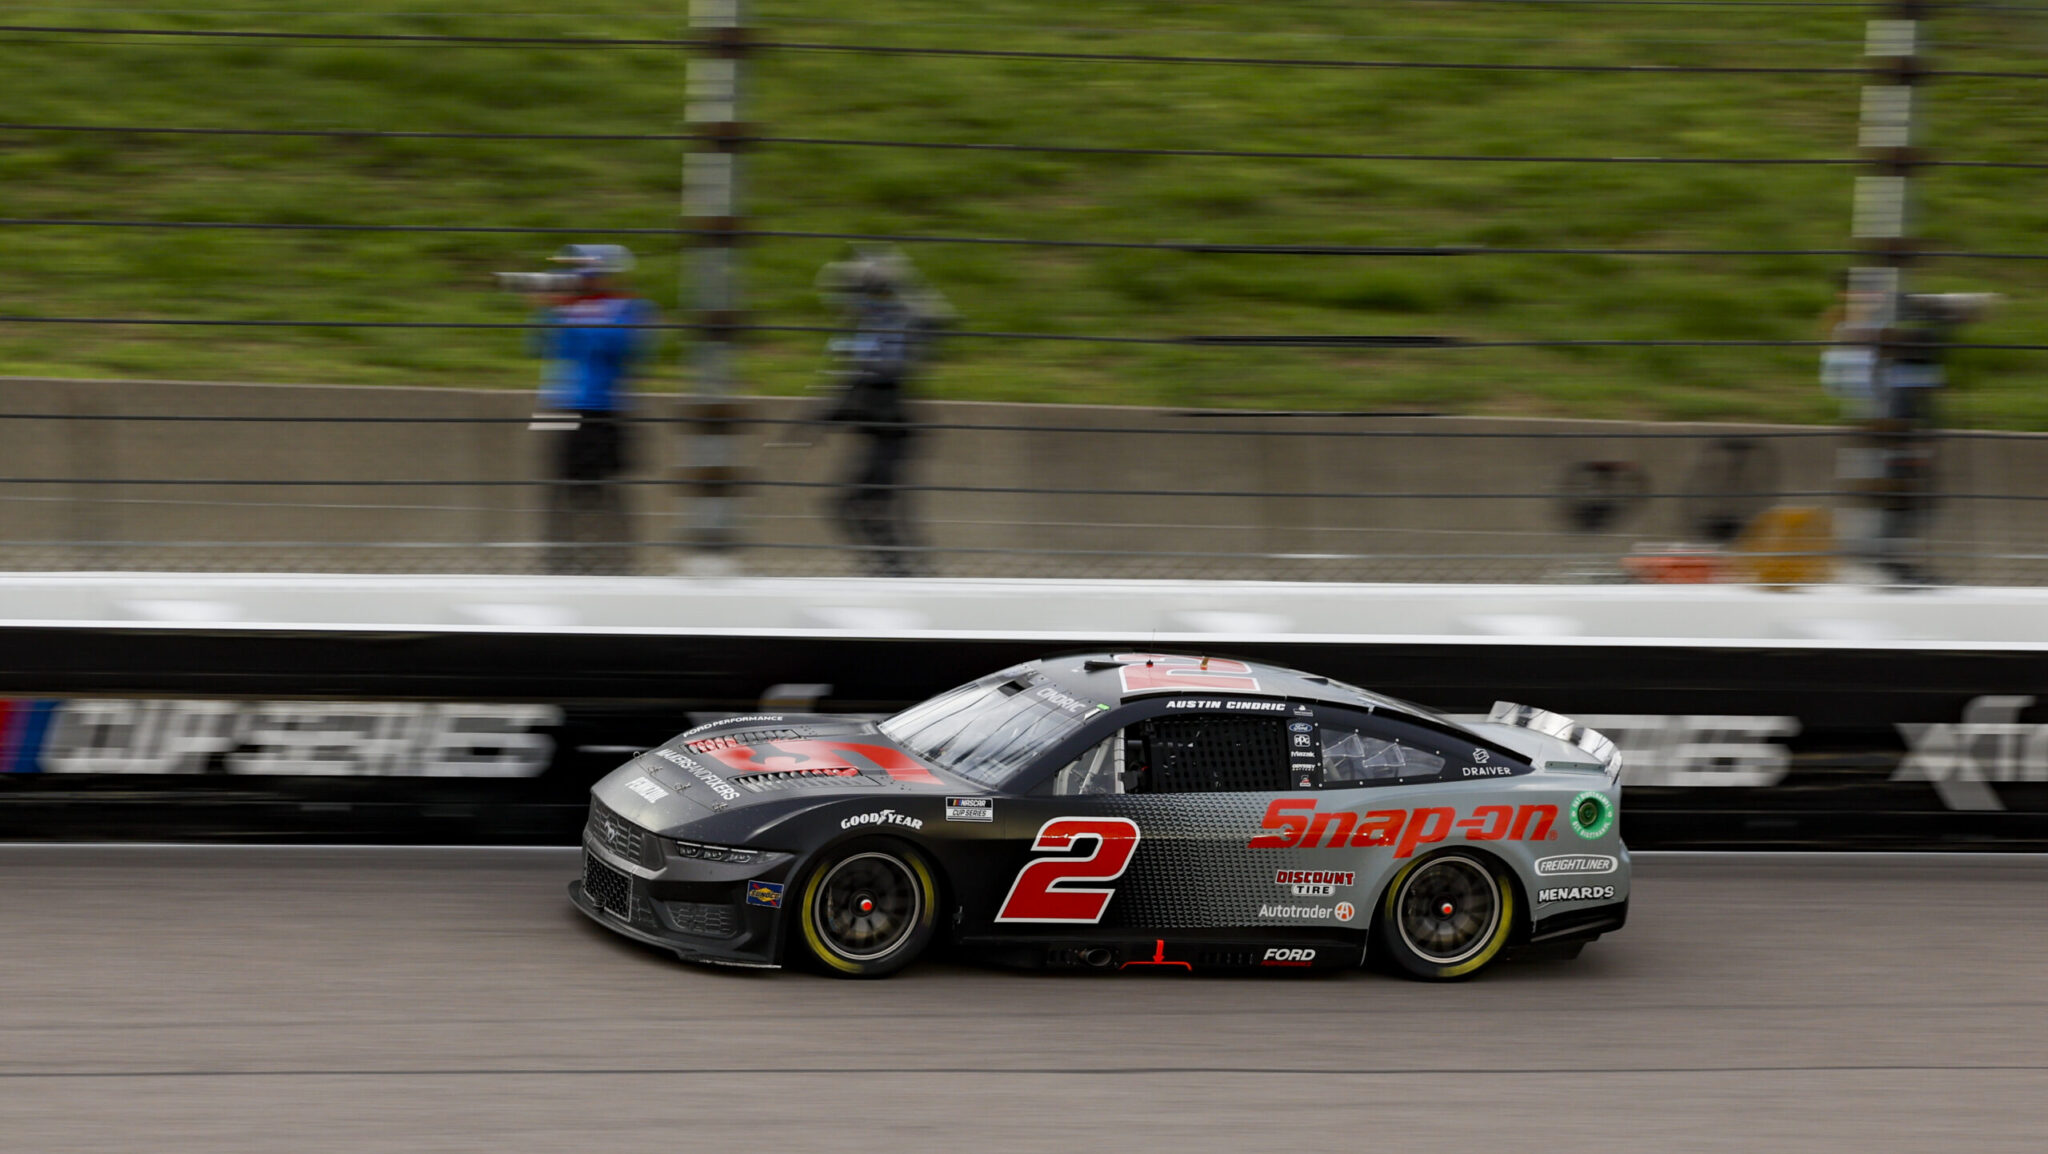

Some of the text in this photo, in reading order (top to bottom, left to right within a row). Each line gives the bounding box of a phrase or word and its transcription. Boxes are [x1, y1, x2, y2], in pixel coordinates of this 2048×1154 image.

[1113, 653, 1261, 693] 2
[1037, 687, 1086, 712] CINDRIC
[1166, 700, 1221, 709] AUSTIN
[1226, 701, 1286, 711] CINDRIC
[683, 715, 783, 738] FORD PERFORMANCE
[1290, 750, 1315, 758] Mazak
[1462, 766, 1512, 776] DRAIVER
[960, 799, 987, 807] NASCAR
[841, 809, 923, 830] GOODYEAR
[952, 809, 987, 817] CUP SERIES
[1247, 798, 1559, 859] Snap-on
[994, 816, 1141, 924] 2
[1540, 859, 1611, 871] FREIGHTLINER
[1275, 869, 1355, 887] DISCOUNT
[1296, 885, 1330, 895] TIRE
[1538, 886, 1614, 902] MENARDS
[1258, 903, 1333, 919] Autotrader
[1263, 948, 1316, 961] FORD
